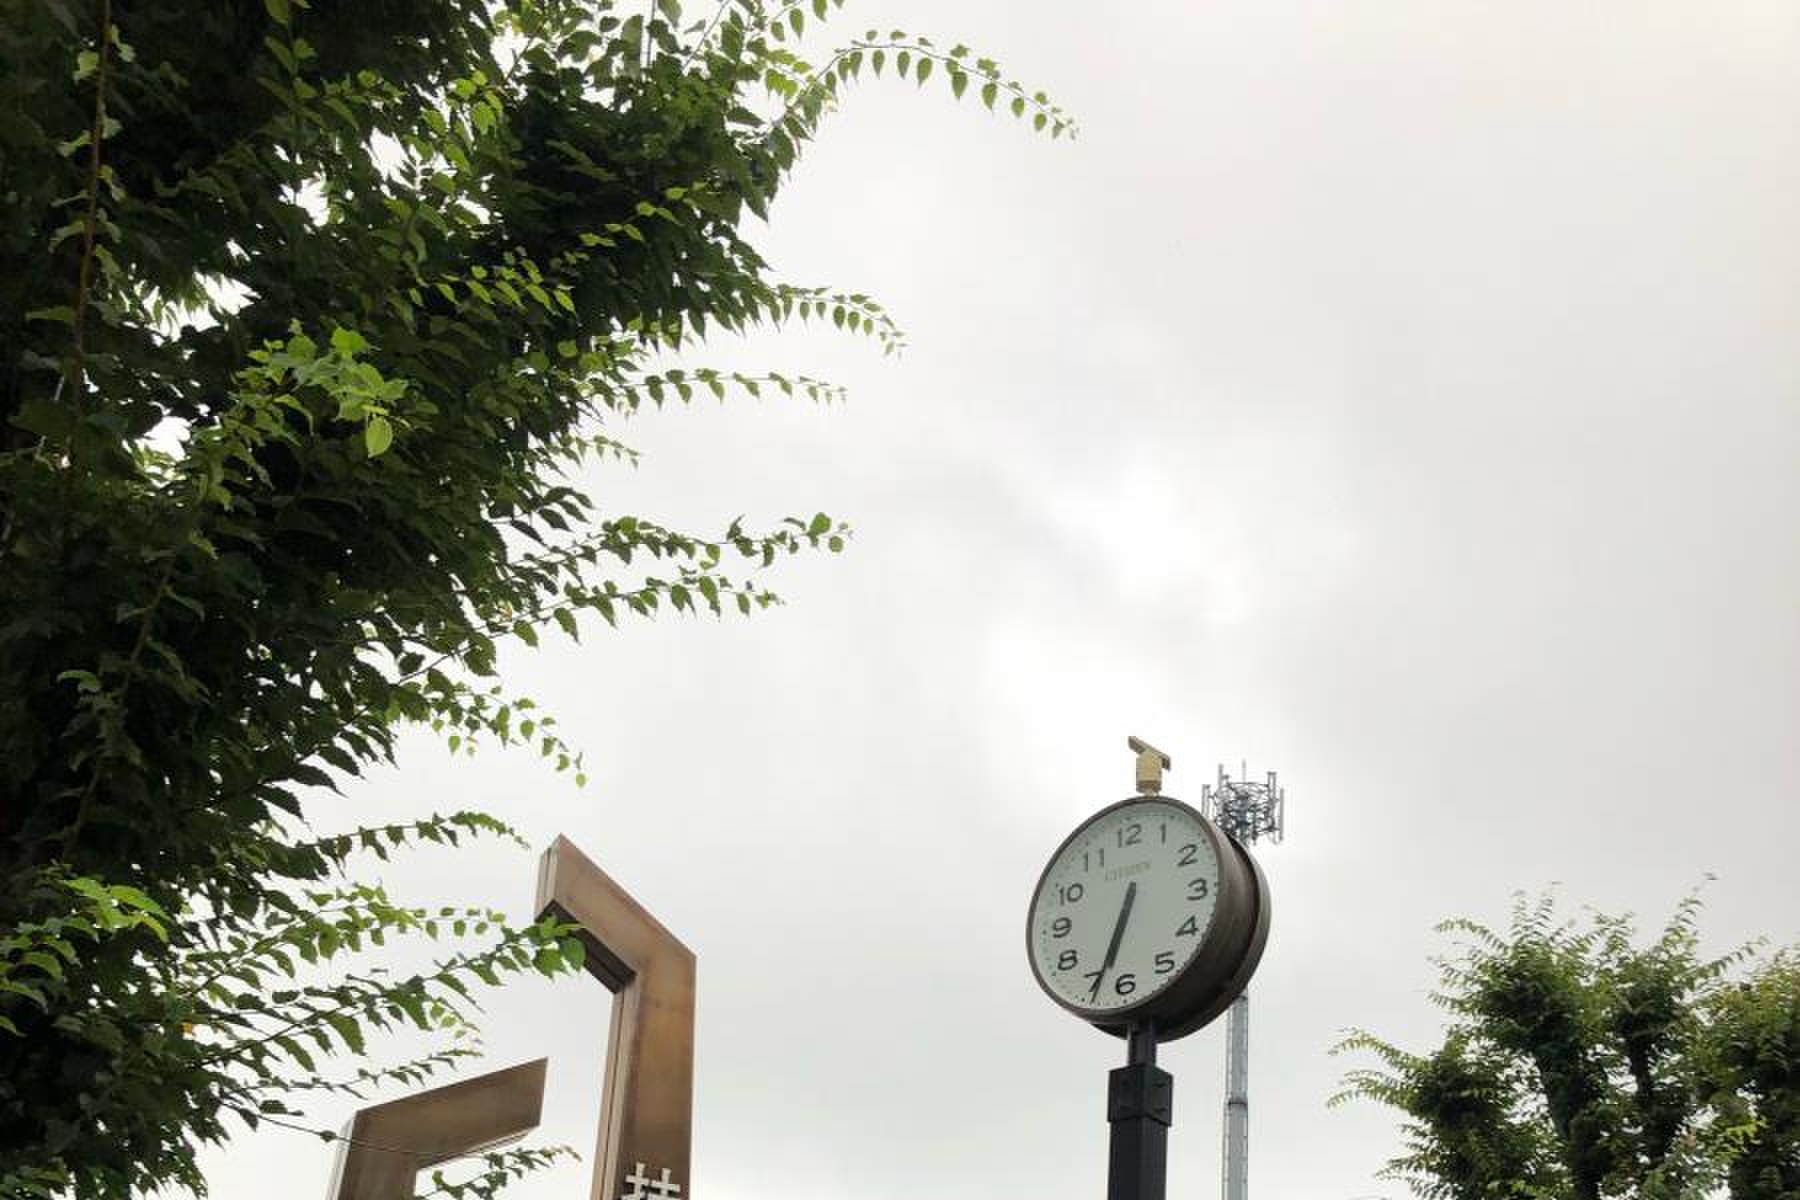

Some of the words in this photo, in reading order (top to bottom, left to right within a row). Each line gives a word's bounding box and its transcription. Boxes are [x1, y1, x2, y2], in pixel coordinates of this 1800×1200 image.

[1117, 823, 1142, 848] 12
[1160, 823, 1166, 845] 1
[1083, 848, 1104, 872] 11
[1177, 844, 1198, 867] 2
[1056, 883, 1084, 905] 10
[1187, 878, 1208, 900] 3
[1052, 917, 1072, 938] 9
[1175, 916, 1198, 937] 4
[1057, 950, 1078, 970] 8
[1155, 951, 1175, 974] 5
[1084, 971, 1104, 993] 7
[1115, 973, 1136, 995] 6
